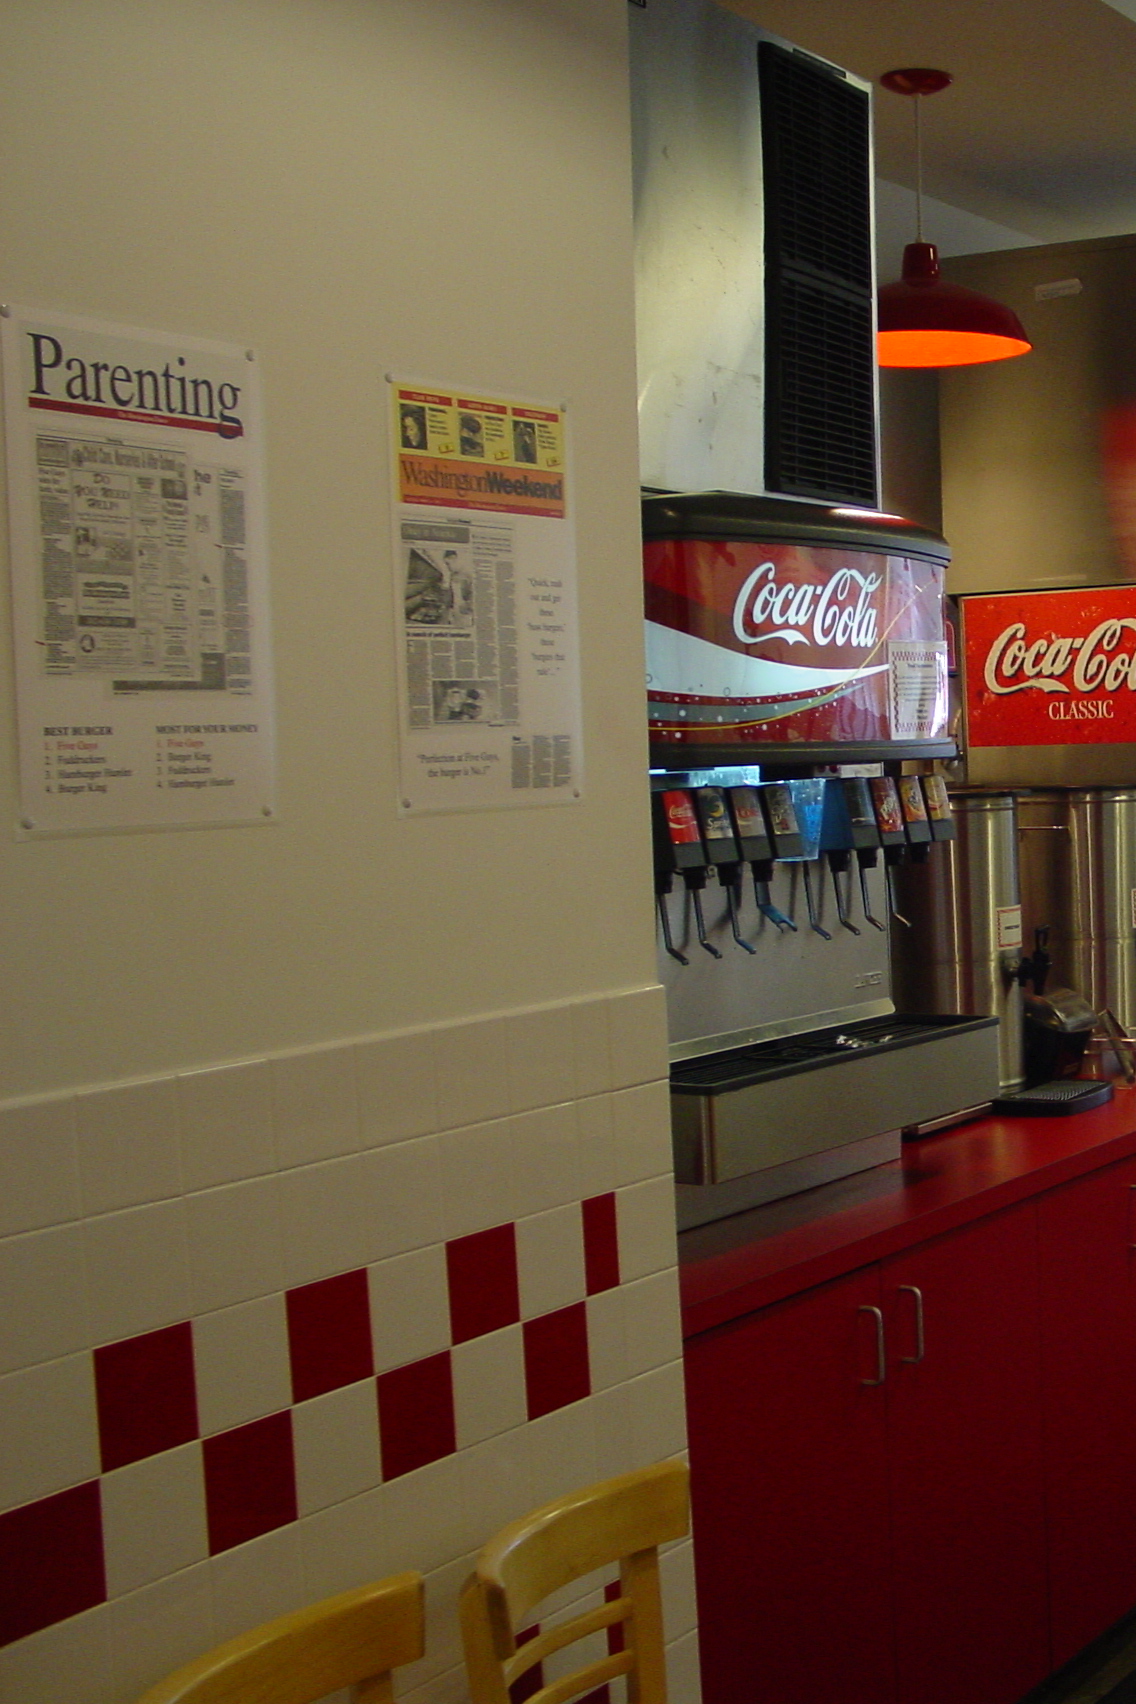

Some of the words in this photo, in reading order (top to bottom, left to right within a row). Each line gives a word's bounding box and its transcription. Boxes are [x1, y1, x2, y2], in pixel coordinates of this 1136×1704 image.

[27, 332, 241, 439] Parenting
[733, 562, 882, 647] Coca-Cola
[1048, 699, 1114, 720] CLASSIC
[43, 726, 69, 736] BEST
[72, 726, 113, 736] BURGER
[156, 725, 181, 735] MOST
[183, 724, 202, 734] FOR
